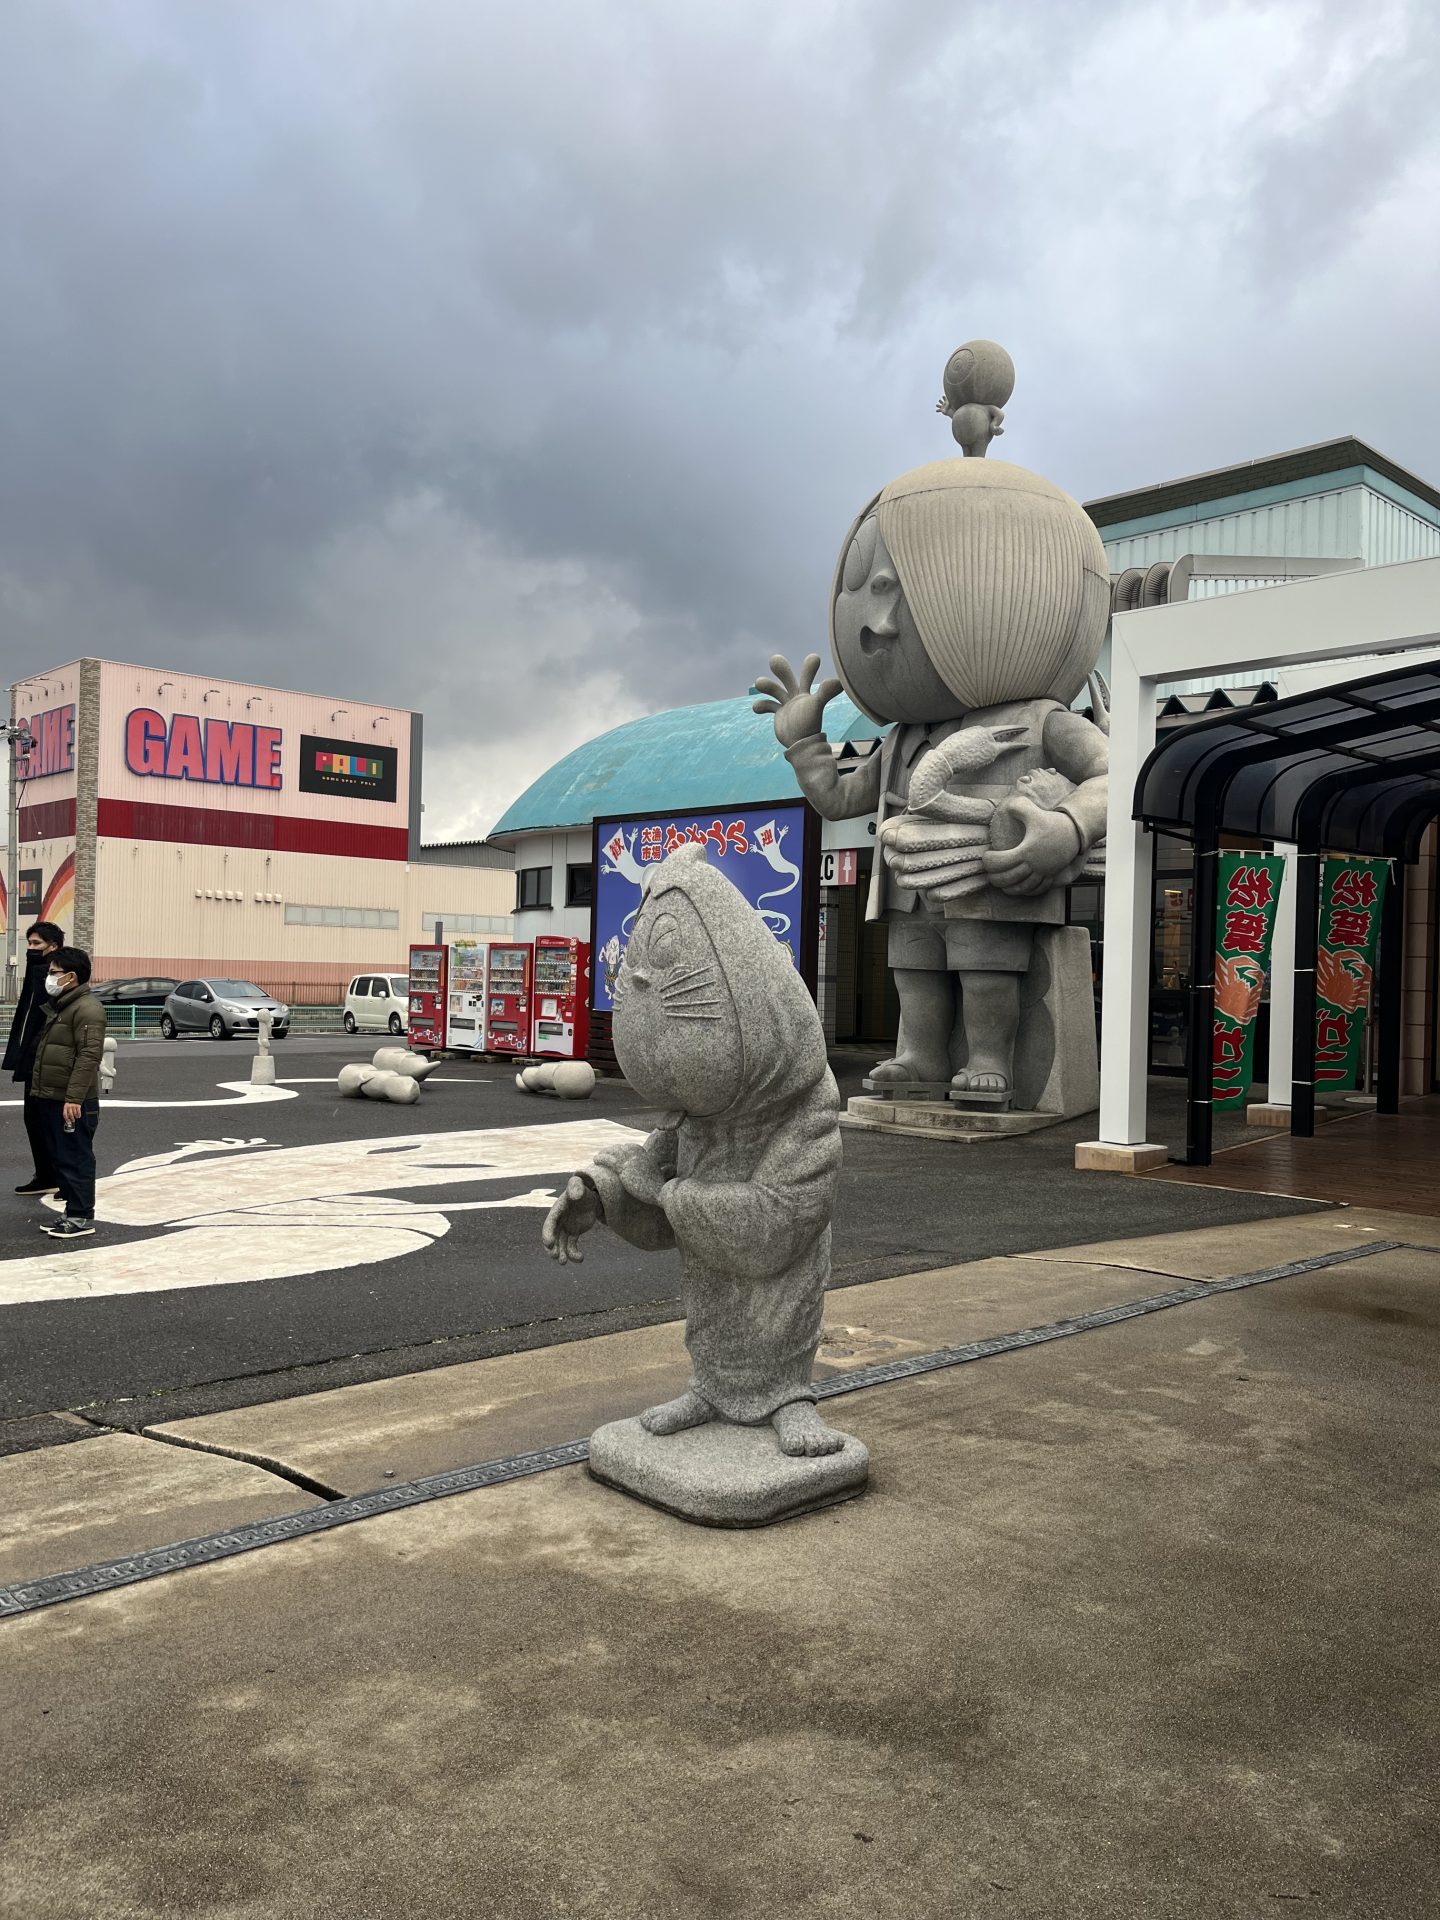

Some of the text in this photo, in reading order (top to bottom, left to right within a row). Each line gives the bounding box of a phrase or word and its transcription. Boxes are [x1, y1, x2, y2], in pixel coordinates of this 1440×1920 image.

[125, 707, 283, 790] GAME
[315, 751, 384, 779] PALO
[641, 827, 663, 843] 大漁
[641, 846, 663, 861] 市場
[820, 854, 834, 881] C
